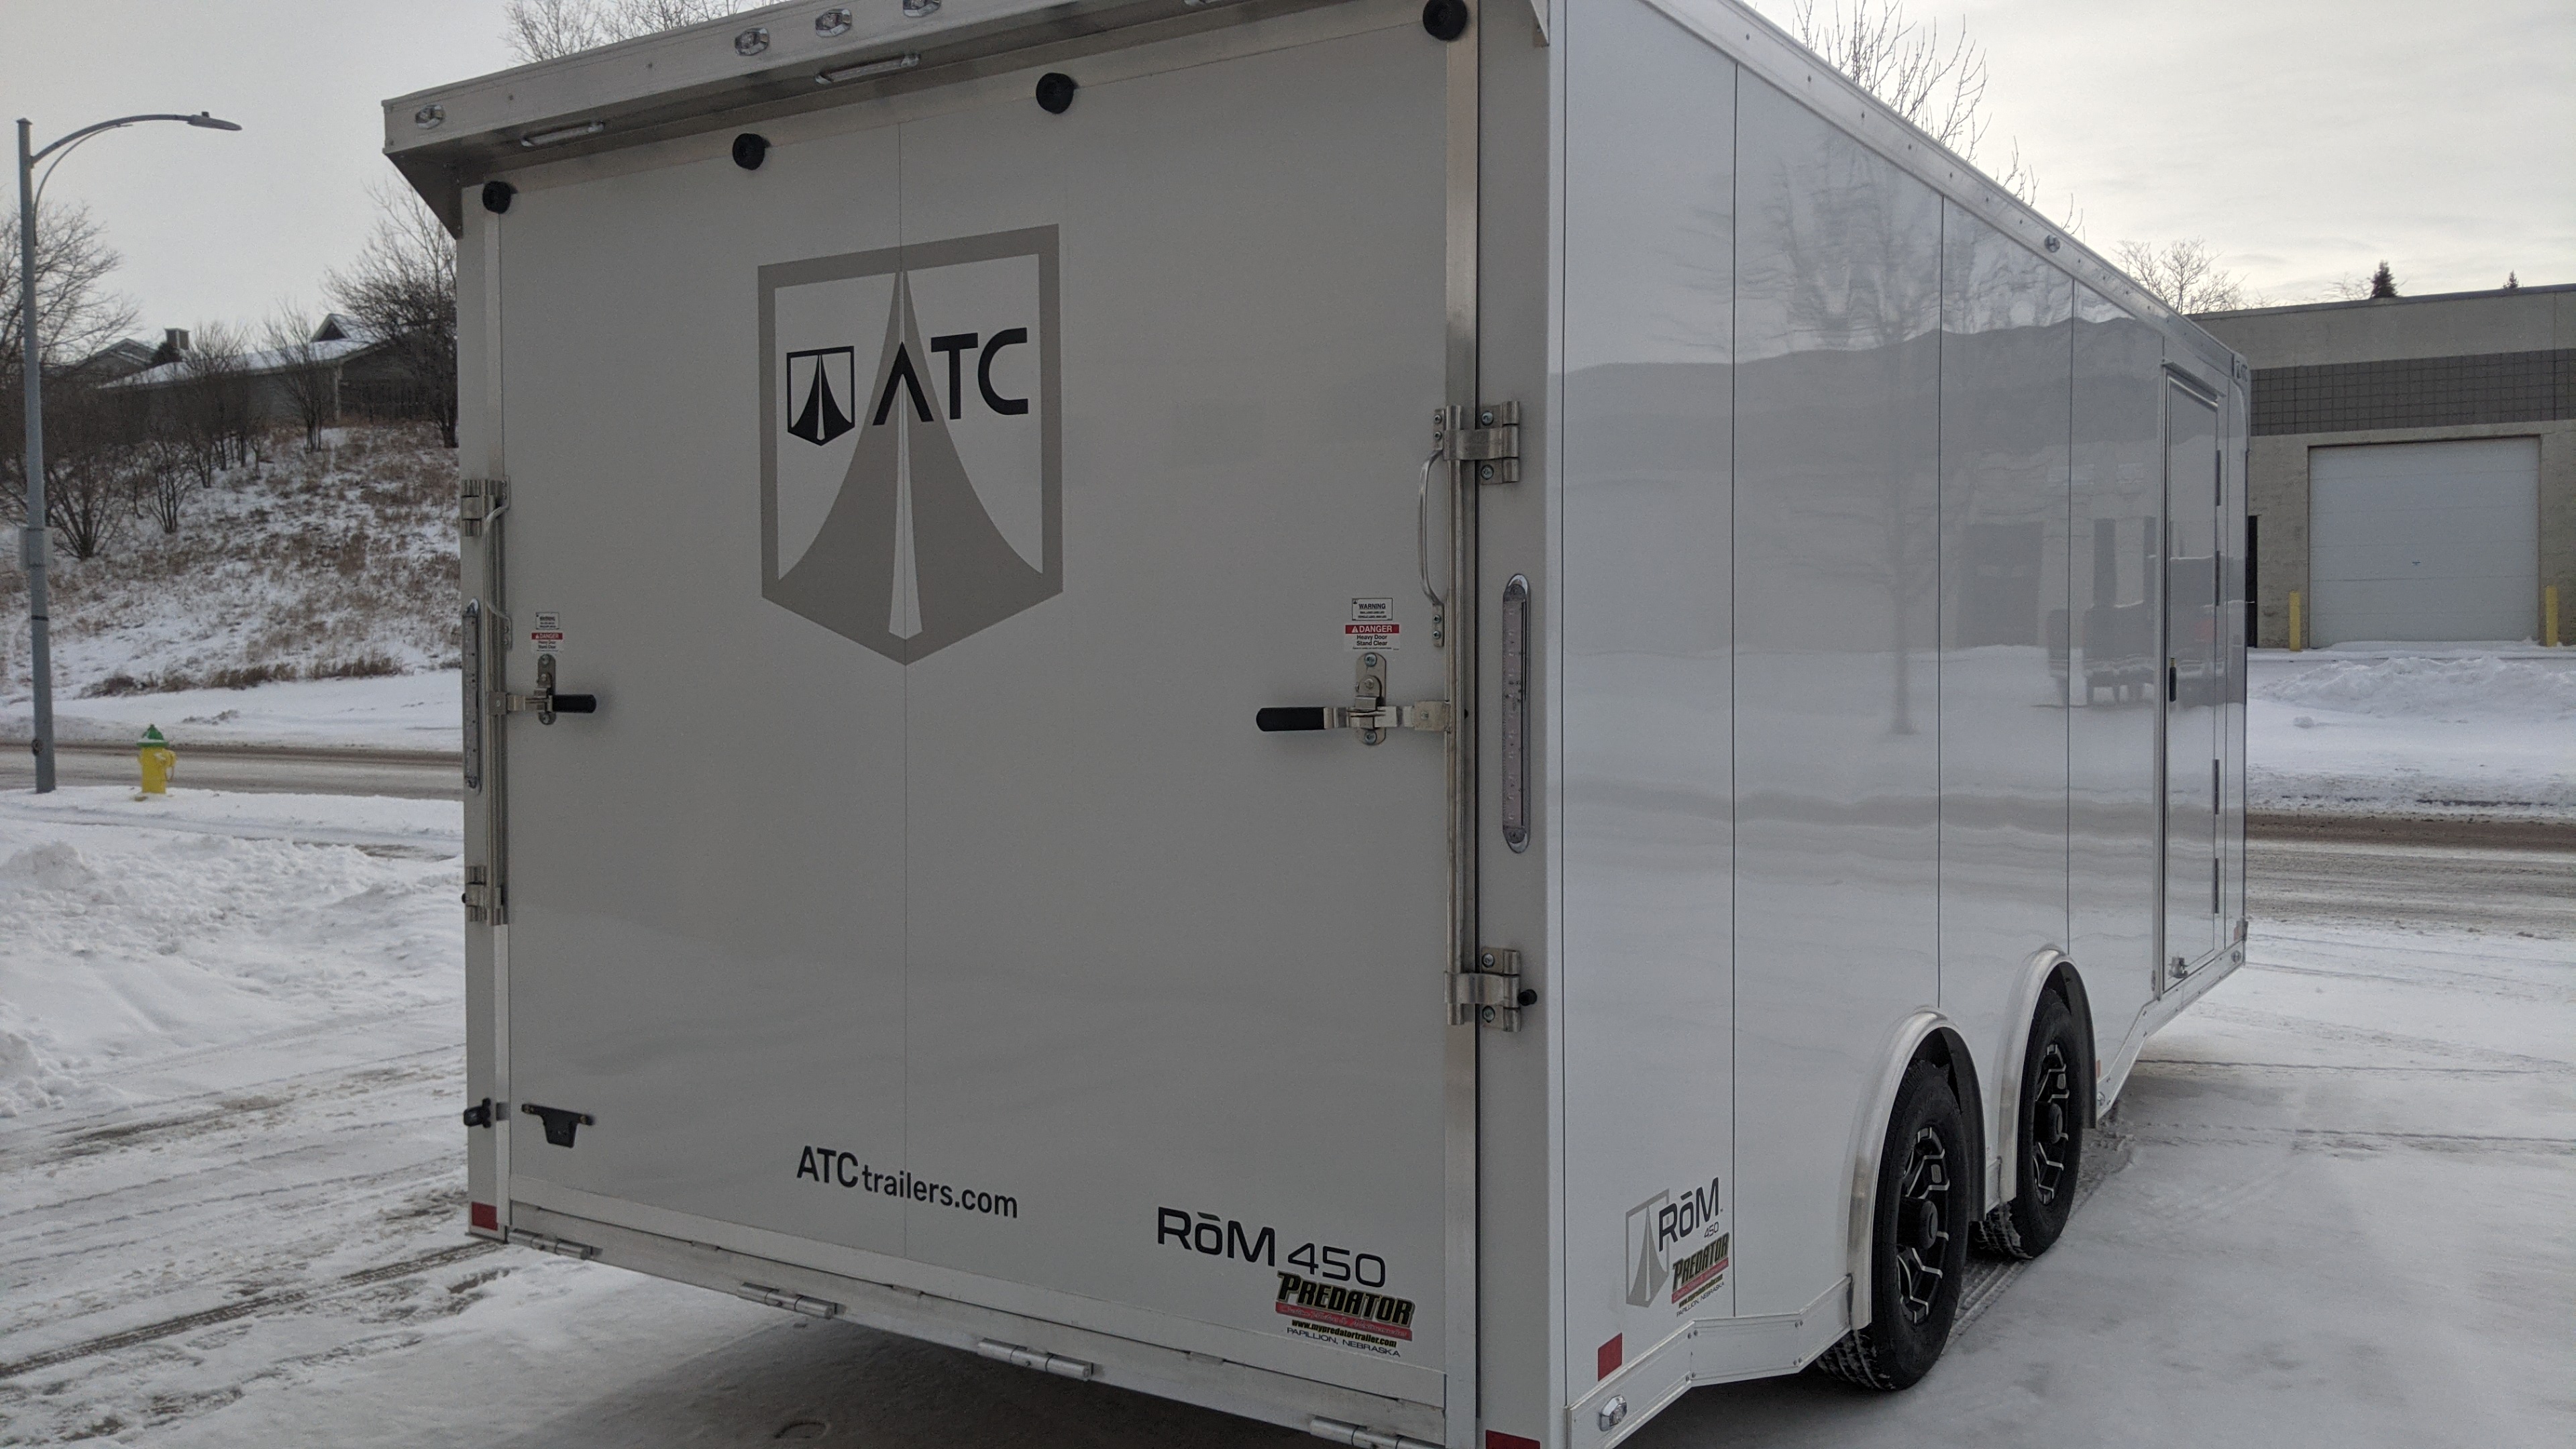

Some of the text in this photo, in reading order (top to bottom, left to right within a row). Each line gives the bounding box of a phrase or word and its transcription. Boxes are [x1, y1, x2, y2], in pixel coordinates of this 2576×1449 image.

[873, 327, 1029, 426] ATC
[1359, 625, 1393, 633] DANGER
[1704, 1222, 1719, 1238] 450
[1288, 1242, 1386, 1288] 450
[1672, 1232, 1730, 1292] PREDATOR
[1277, 1271, 1415, 1327] PREDATOR
[1287, 1327, 1338, 1345] PAPILLION,
[1342, 1339, 1401, 1357] NEBRASKA
[1292, 1319, 1397, 1348] www.mypredatortrailer.com
